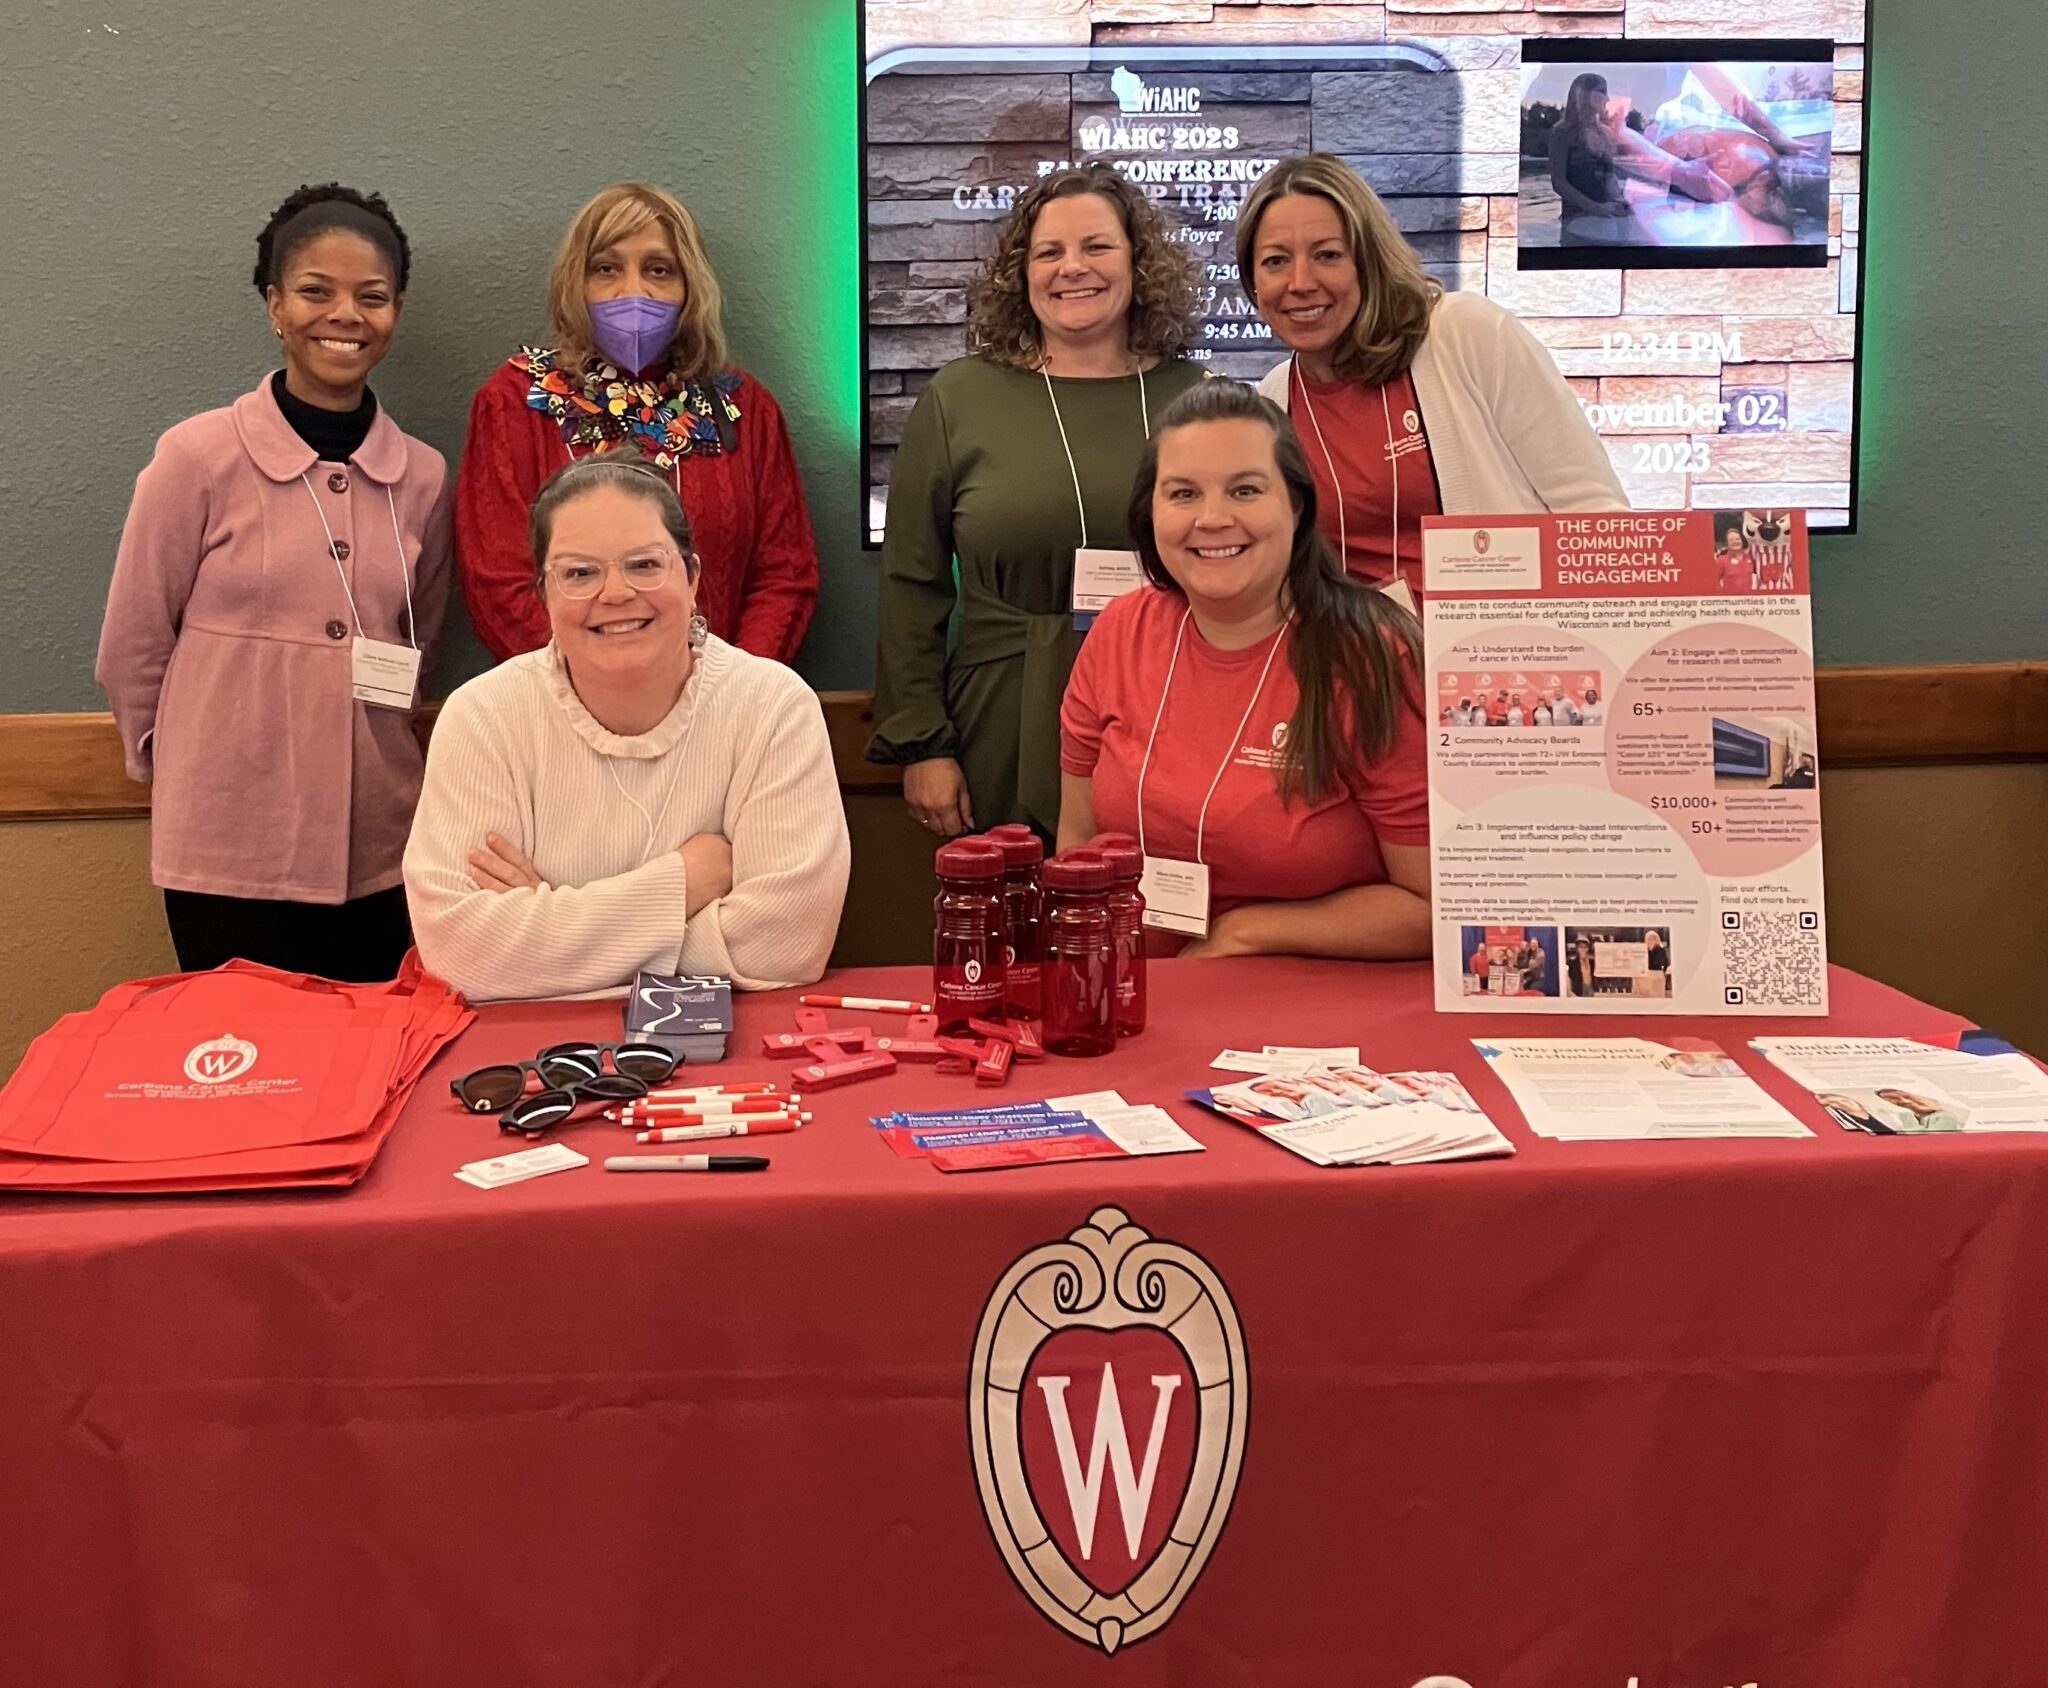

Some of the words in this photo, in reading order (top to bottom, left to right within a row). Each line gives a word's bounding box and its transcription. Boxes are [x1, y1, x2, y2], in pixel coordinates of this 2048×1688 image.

[1139, 81, 1201, 112] WiAHC
[1080, 124, 1167, 150] WIAHC
[1172, 127, 1239, 150] 2023
[1203, 206, 1238, 221] 7:00
[1181, 227, 1224, 246] Foyer
[1207, 264, 1240, 281] 7:30
[1217, 297, 1258, 317] AM
[1205, 323, 1239, 339] 9:45
[1241, 322, 1273, 339] AM
[1600, 331, 1681, 364] 12:34
[1687, 331, 1743, 363] PM
[1577, 394, 1731, 428] ovember
[1738, 394, 1788, 431] 02,
[1632, 442, 1712, 475] 2023
[1556, 520, 1591, 533] THE
[1596, 519, 1657, 533] OFFICE
[1662, 518, 1687, 532] OF
[1557, 535, 1666, 550] COMMUNITY
[1557, 553, 1657, 567] OUTREACH
[1662, 552, 1675, 566] &
[1558, 569, 1682, 584] ENGAGEMENT
[1535, 601, 1589, 609] community
[1435, 611, 1477, 619] research
[1525, 610, 1539, 618] for
[1543, 610, 1589, 619] defeating
[1628, 609, 1646, 617] and
[1650, 609, 1696, 618] achieving
[1700, 608, 1731, 616] health
[1734, 608, 1765, 617] equity
[1634, 620, 1672, 629] beyond.
[1682, 649, 1715, 657] Engage
[1633, 702, 1664, 716] 65+
[1440, 734, 1450, 746] 2
[1454, 737, 1504, 745] Community
[1507, 736, 1548, 744] Advocacy
[1551, 736, 1581, 744] Boards
[1651, 796, 1718, 810] $10,000+
[1692, 820, 1723, 834] 50+
[203, 1053, 240, 1076] W
[247, 1078, 298, 1087] Center
[1037, 1361, 1182, 1561] W
